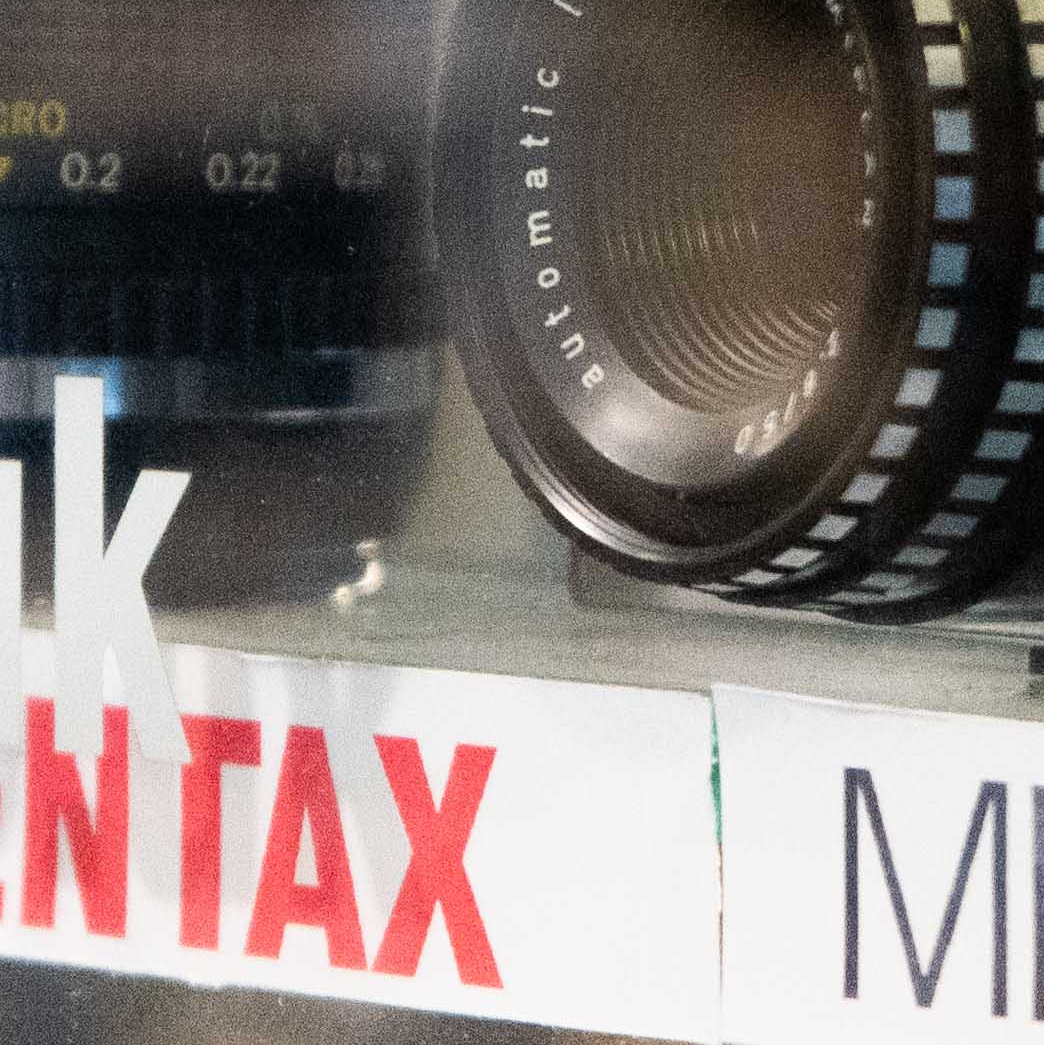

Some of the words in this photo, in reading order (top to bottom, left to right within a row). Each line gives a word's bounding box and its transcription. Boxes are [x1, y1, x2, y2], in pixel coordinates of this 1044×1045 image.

[0, 99, 68, 138] RO
[519, 64, 605, 391] automatic
[0, 696, 503, 989] NTAX
